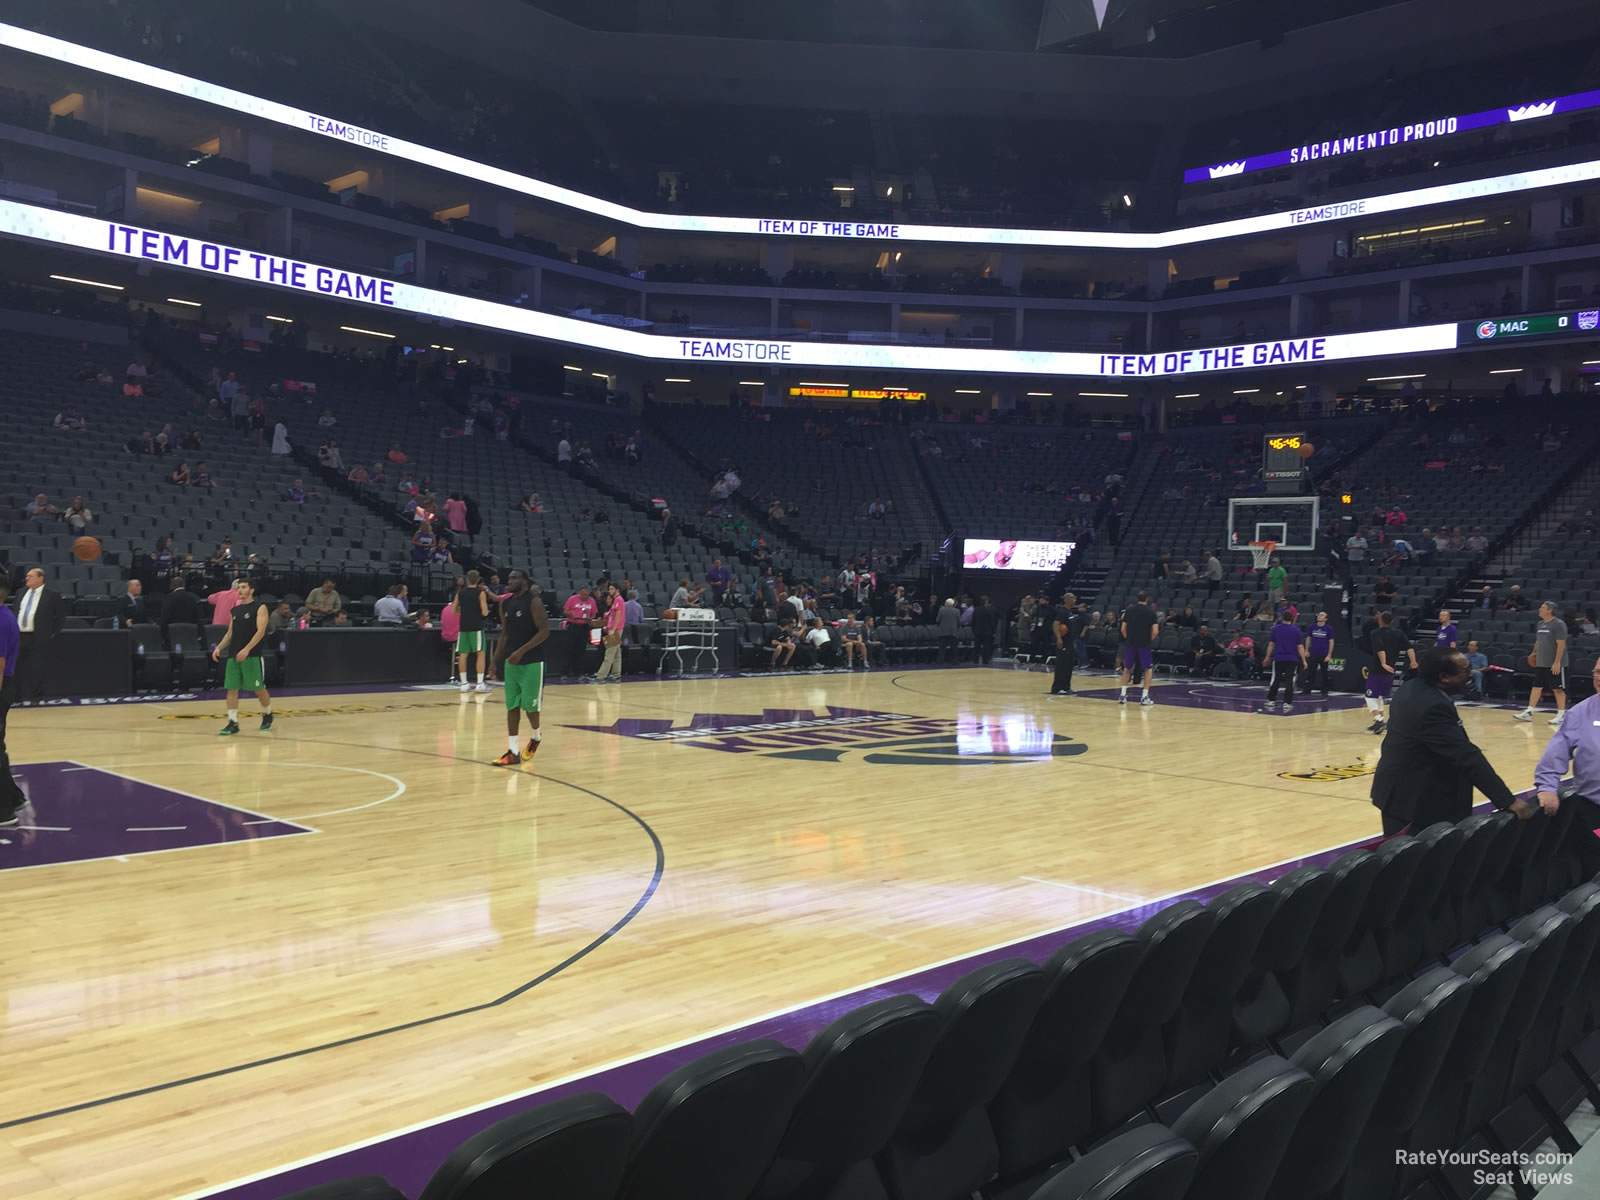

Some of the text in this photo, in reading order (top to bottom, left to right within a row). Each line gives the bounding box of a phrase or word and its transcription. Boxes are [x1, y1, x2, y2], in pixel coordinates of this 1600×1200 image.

[308, 115, 389, 150] TEAMSTORE
[1290, 117, 1457, 164] SACRAMENTO PROUD
[1289, 200, 1366, 224] TEAMSTORE
[759, 220, 899, 237] ITEM OF THE GAME
[108, 224, 395, 306] ITEM OF THE GAME
[1500, 320, 1528, 333] MAC
[679, 340, 792, 360] TEAMSTORE
[1100, 338, 1326, 375] ITEM OF THE GAME
